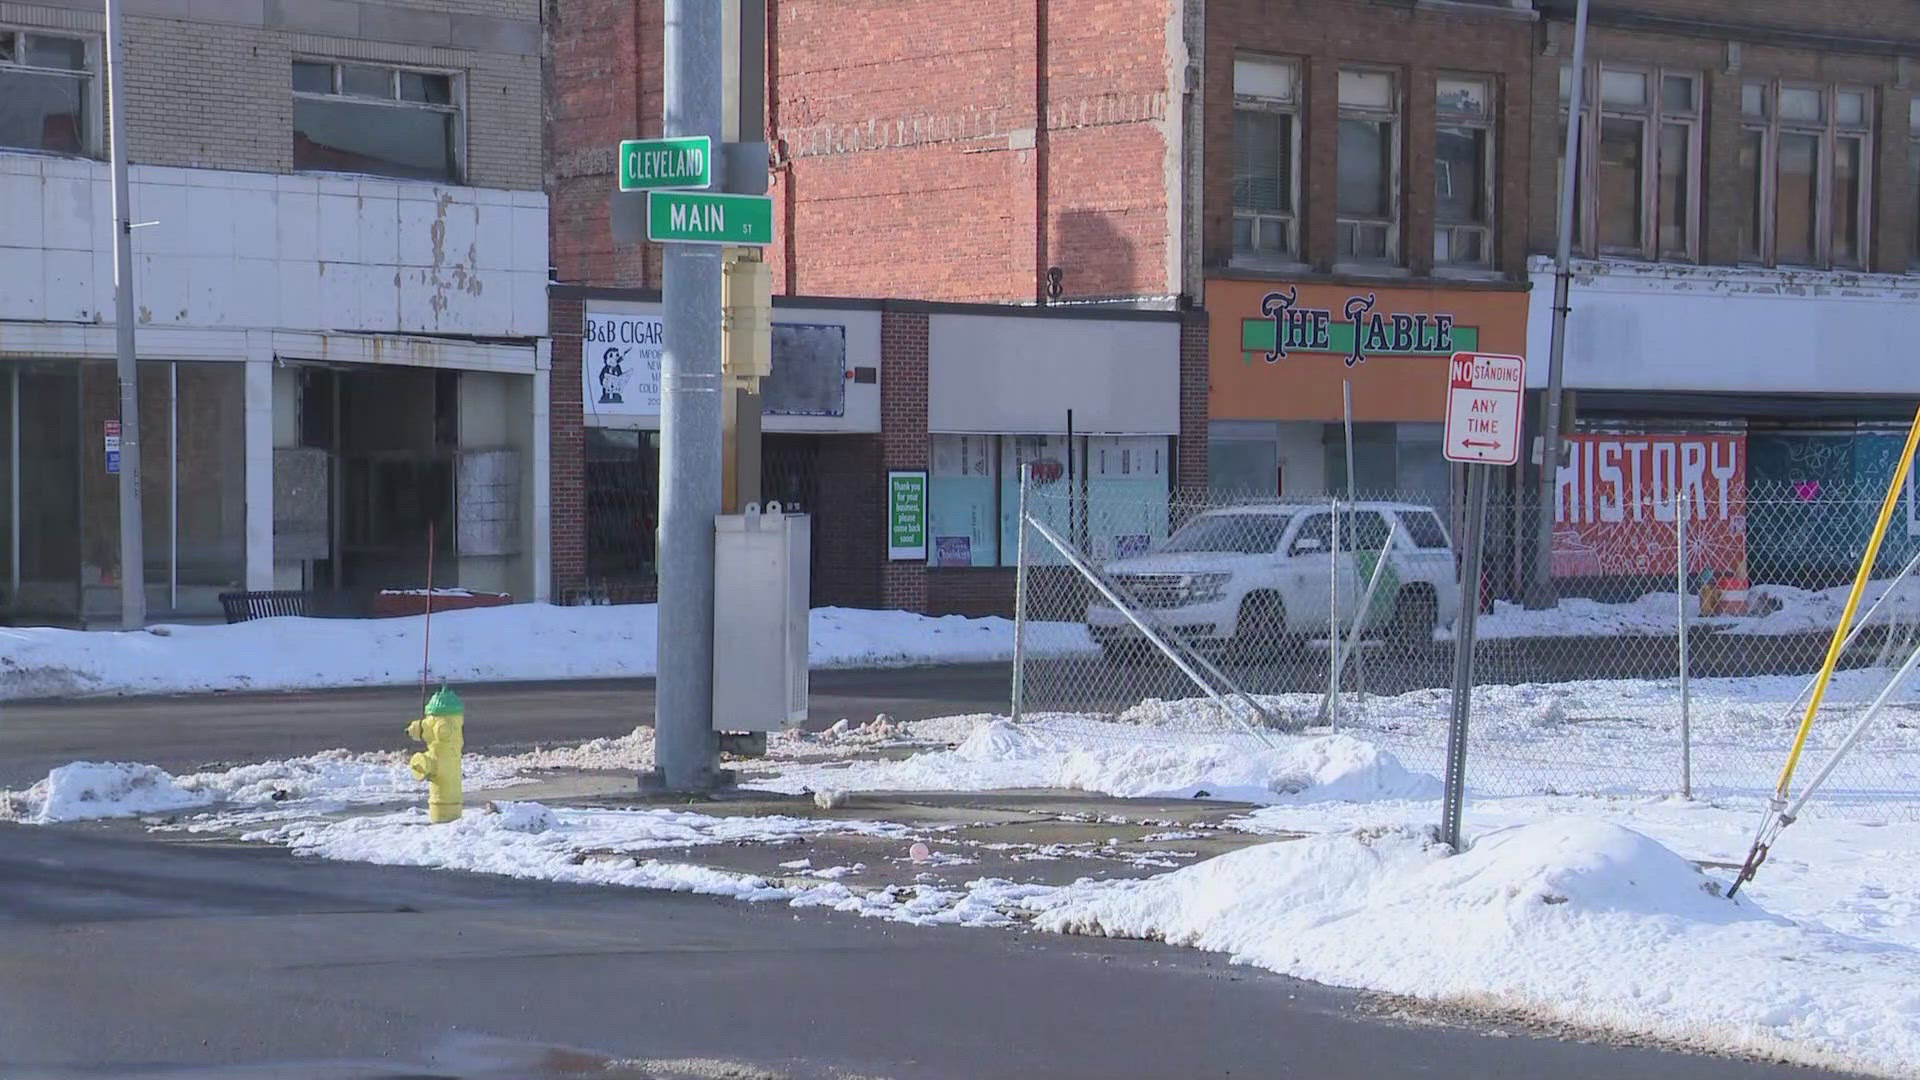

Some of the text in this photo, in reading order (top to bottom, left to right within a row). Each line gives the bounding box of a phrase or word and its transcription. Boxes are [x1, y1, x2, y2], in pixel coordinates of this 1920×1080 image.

[628, 148, 704, 180] CLEVELAND
[670, 203, 753, 235] MAIN ST
[587, 319, 663, 345] B&B CIGAR
[1261, 284, 1454, 368] THE TABLE
[1452, 360, 1519, 382] NO STANDING
[639, 383, 659, 394] COLD
[1471, 399, 1498, 414] ANY
[1467, 418, 1499, 434] TIME
[894, 480, 921, 493] Thank you
[1555, 441, 1737, 524] HISTORY
[897, 491, 919, 504] for your
